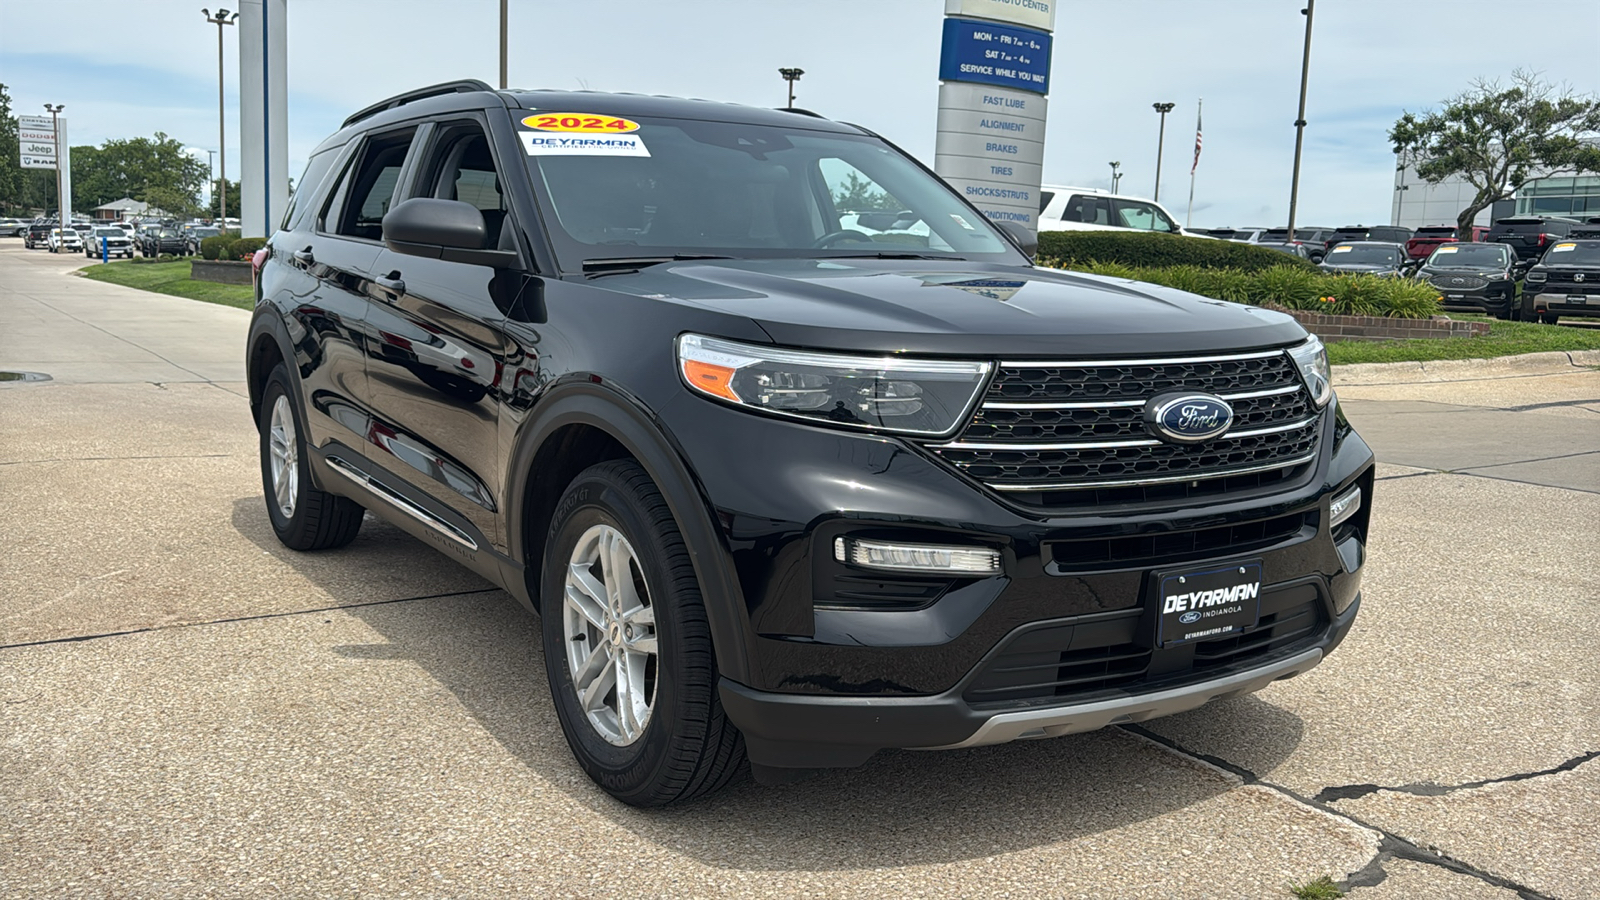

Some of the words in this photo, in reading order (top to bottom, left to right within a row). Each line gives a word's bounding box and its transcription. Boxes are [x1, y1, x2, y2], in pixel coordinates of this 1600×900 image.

[1022, 0, 1049, 13] CENTER
[973, 31, 992, 41] MON
[1000, 34, 1012, 44] FRI
[985, 49, 999, 59] SAT
[960, 63, 993, 76] SERVICE
[995, 67, 1016, 79] WHILE
[1018, 71, 1031, 81] YOU
[1032, 73, 1045, 84] WAIT
[983, 95, 1004, 106] FAST
[1005, 98, 1025, 109] LUBE
[537, 117, 629, 130] 2024
[980, 119, 1025, 132] ALIGNMENT
[532, 138, 636, 146] DEYARMAN
[985, 142, 1018, 154] BRAKES
[28, 144, 52, 154] Jeep
[990, 165, 1013, 176] TIRES
[966, 186, 1029, 200] SHOCKS/STRUTS
[981, 209, 1030, 222] ONDITIONING
[1178, 404, 1219, 430] Ford
[1163, 582, 1260, 614] DEYARMAN
[1203, 605, 1242, 618] INDIANOLA
[1185, 625, 1233, 639] DEYARMANFORD.COM
